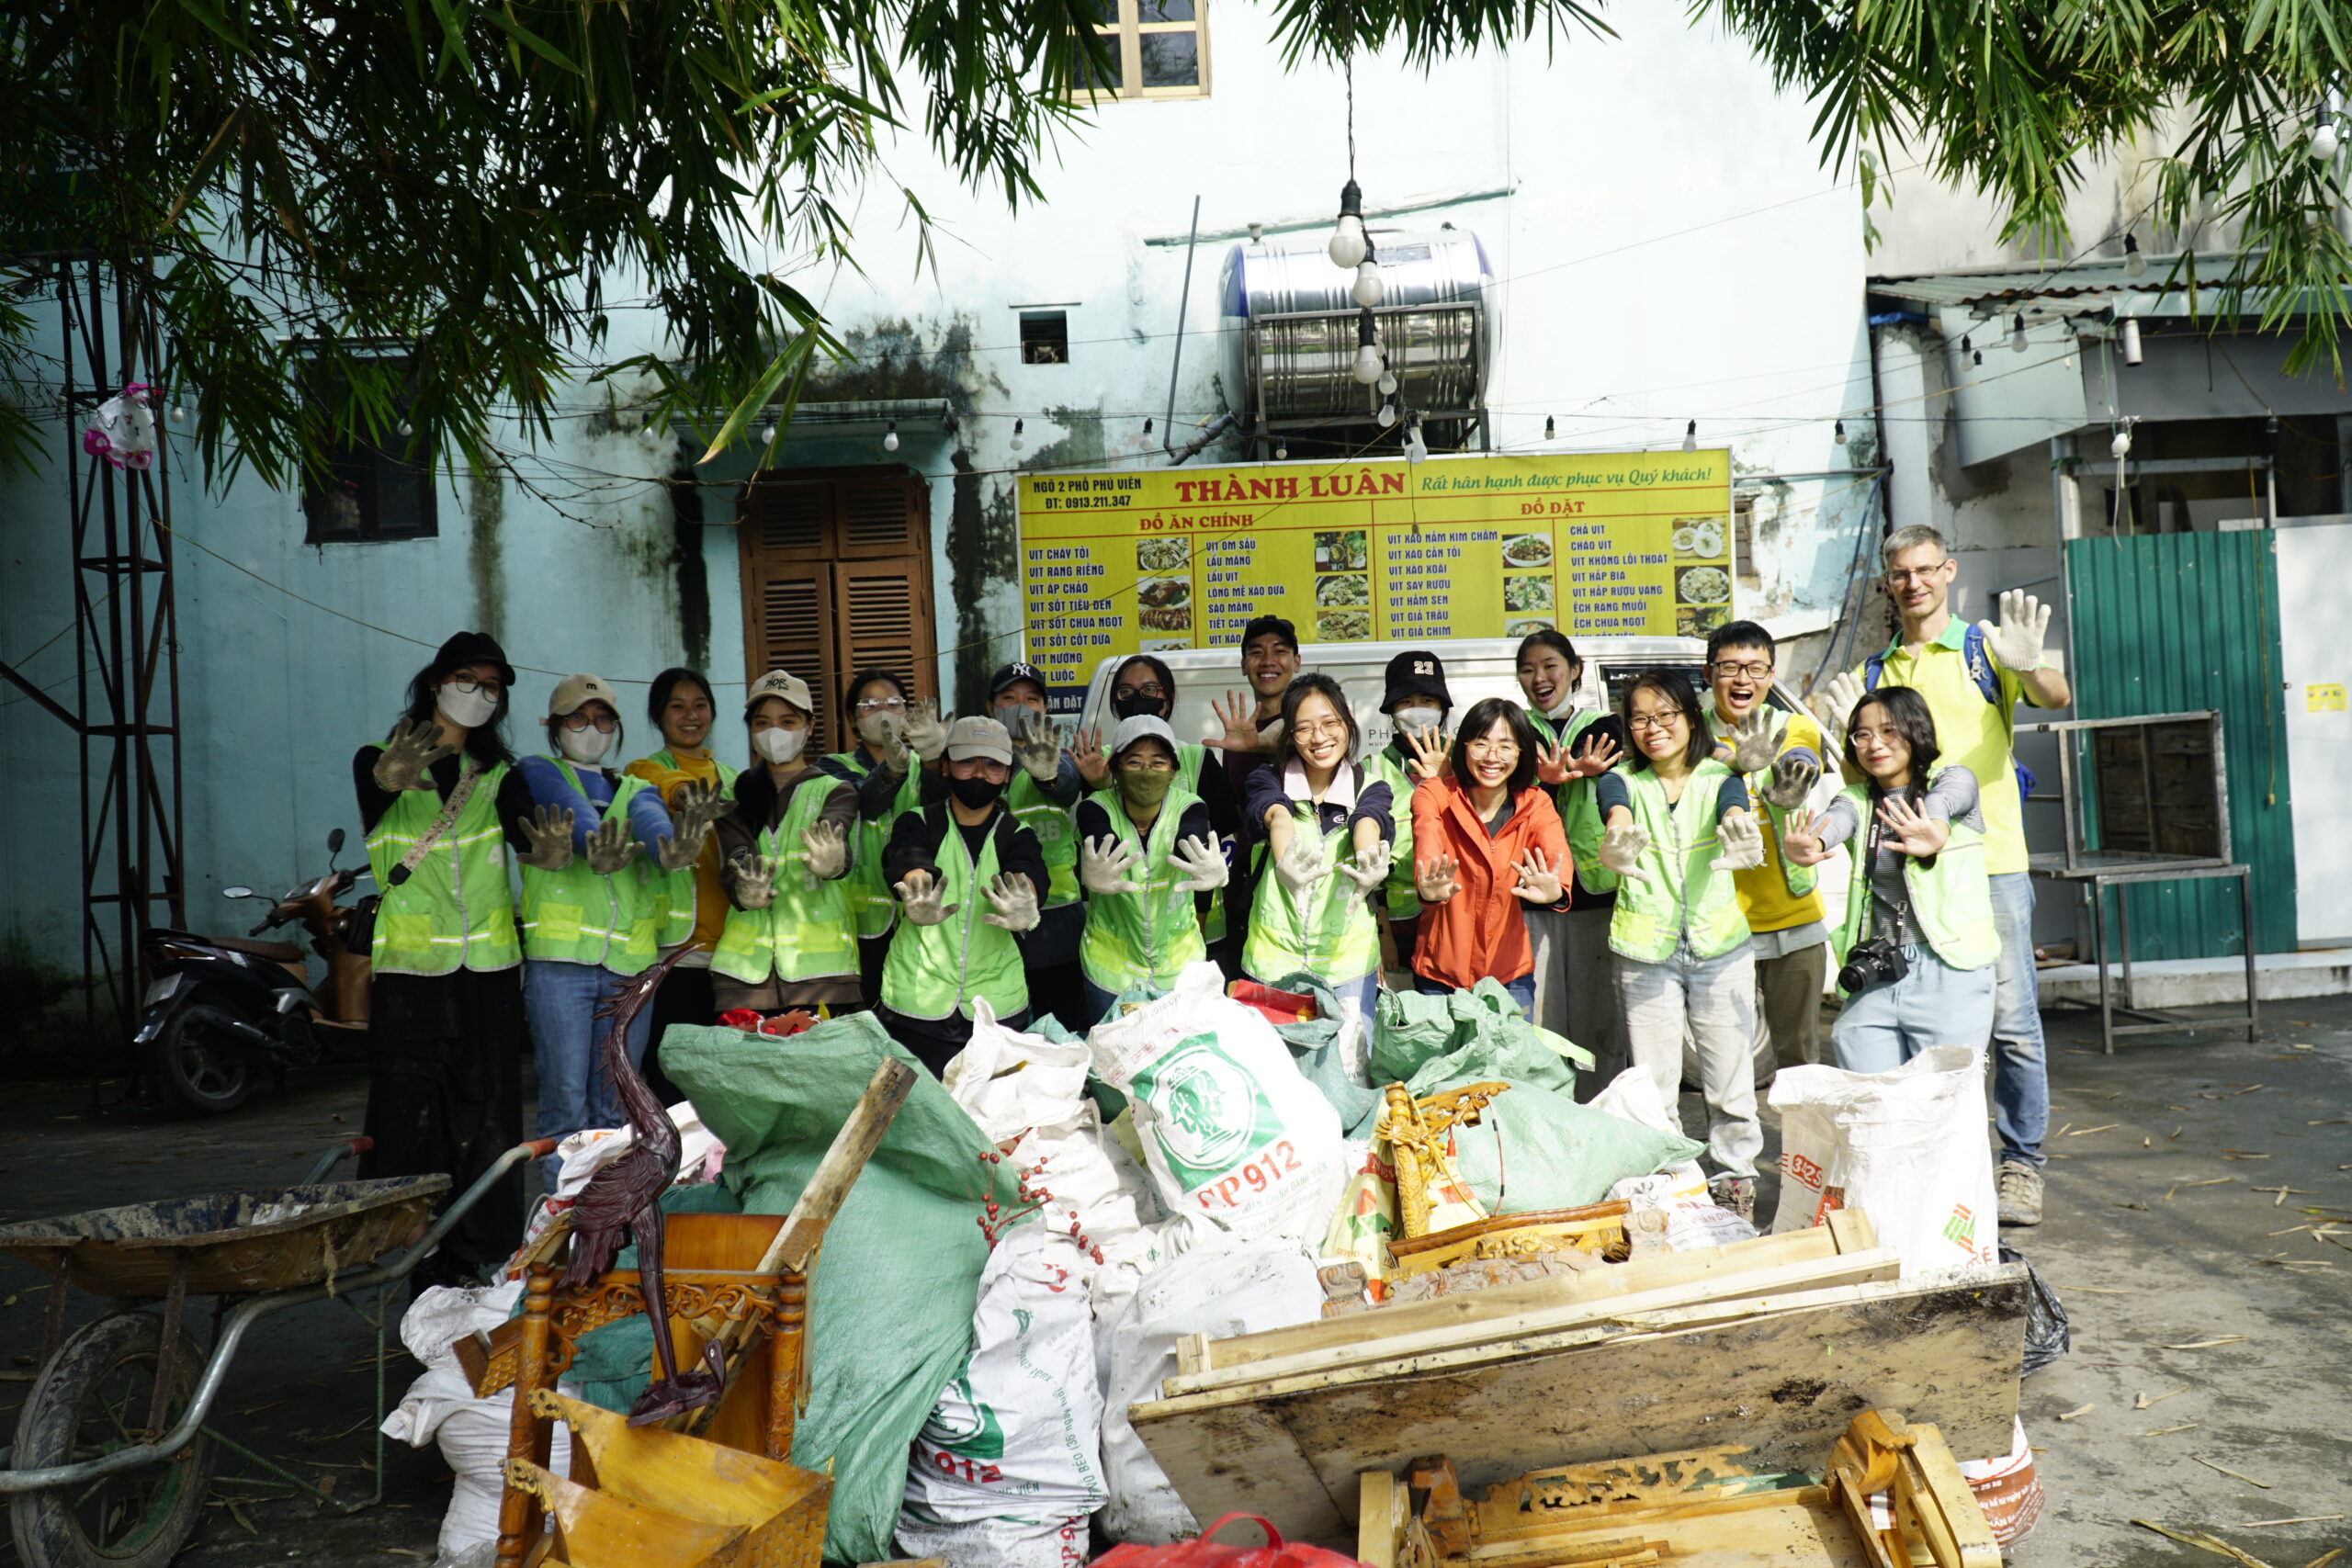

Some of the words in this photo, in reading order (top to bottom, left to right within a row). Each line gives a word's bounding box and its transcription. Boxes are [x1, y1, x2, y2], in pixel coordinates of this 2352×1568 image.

[1034, 479, 1055, 493] NGÕ
[1058, 481, 1065, 492] 2
[1069, 475, 1089, 492] PHỐ
[1093, 476, 1114, 491] PHÚ
[1117, 476, 1142, 491] VIÊN
[1175, 473, 1298, 502] THÀNH
[1309, 467, 1406, 497] LUÂN
[1421, 475, 1448, 491] Rất
[1452, 476, 1481, 490] hân
[1485, 475, 1523, 491] hạnh
[1527, 474, 1563, 489] được
[1566, 471, 1602, 489] phục
[1607, 473, 1624, 487] vụ
[1629, 468, 1658, 486] Quý
[1662, 467, 1713, 482] khách!
[1046, 497, 1062, 509] ĐT:
[1066, 495, 1131, 508] 0913.211.347
[1521, 497, 1544, 515] ĐỒ
[1550, 498, 1585, 517] ĐẶT
[1140, 512, 1164, 530] ĐỒ
[1169, 514, 1193, 529] ĂN
[1199, 512, 1253, 527] CHÍNH
[1591, 525, 1605, 536] VỊT
[1387, 535, 1401, 546] VỊT
[1449, 532, 1467, 542] KIM
[1599, 540, 1611, 551] VỊT
[1206, 542, 1218, 553] VỊT
[1222, 541, 1236, 551] OM
[1029, 549, 1044, 563] VỊT
[1388, 550, 1401, 561] VỊT
[1571, 557, 1585, 568] VỊT
[1589, 554, 1619, 566] KHÔNG
[1029, 567, 1044, 580] VỊT
[1047, 566, 1072, 577] RANG
[1076, 561, 1104, 576] RIỀNG
[1226, 571, 1238, 584] VỊT
[1388, 566, 1402, 577] VỊT
[1572, 572, 1586, 583] VỊT
[1611, 571, 1625, 581] BIA
[1029, 584, 1044, 597] VỊT
[1047, 581, 1060, 594] ÁP
[1063, 580, 1089, 594] CHẢO
[1207, 586, 1229, 598] LÒNG
[1389, 581, 1403, 592] VỊT
[1407, 581, 1423, 591] SAY
[1573, 588, 1586, 599] VỊT
[1638, 585, 1663, 595] VANG
[1030, 602, 1045, 615] VỊT
[1048, 597, 1066, 612] SỐT
[1069, 598, 1090, 611] TIÊU
[1093, 599, 1112, 610] ĐEN
[1390, 597, 1403, 608] VỊT
[1431, 595, 1448, 604] SEN
[1594, 603, 1619, 612] RANG
[1031, 619, 1046, 632] VỊT
[1048, 615, 1067, 629] SỐT
[1069, 617, 1095, 628] CHUA
[1099, 616, 1124, 629] NGỌT
[1390, 613, 1404, 624] VỊT
[1595, 617, 1619, 627] CHUA
[1623, 616, 1645, 628] NGỌT
[1391, 628, 1405, 639] VỊT
[1426, 626, 1451, 637] CHIM
[1031, 637, 1046, 649] VỊT
[1049, 632, 1068, 647] SỐT
[1209, 635, 1222, 646] VỊT
[1032, 654, 1046, 667] VỊT
[1050, 650, 1082, 663] NƯỚNG
[1414, 660, 1433, 675] 23
[1050, 669, 1075, 682] LUỘC
[1047, 695, 1060, 712] ẬN
[1063, 694, 1082, 711] ĐẶT
[1243, 1140, 1302, 1193] 912
